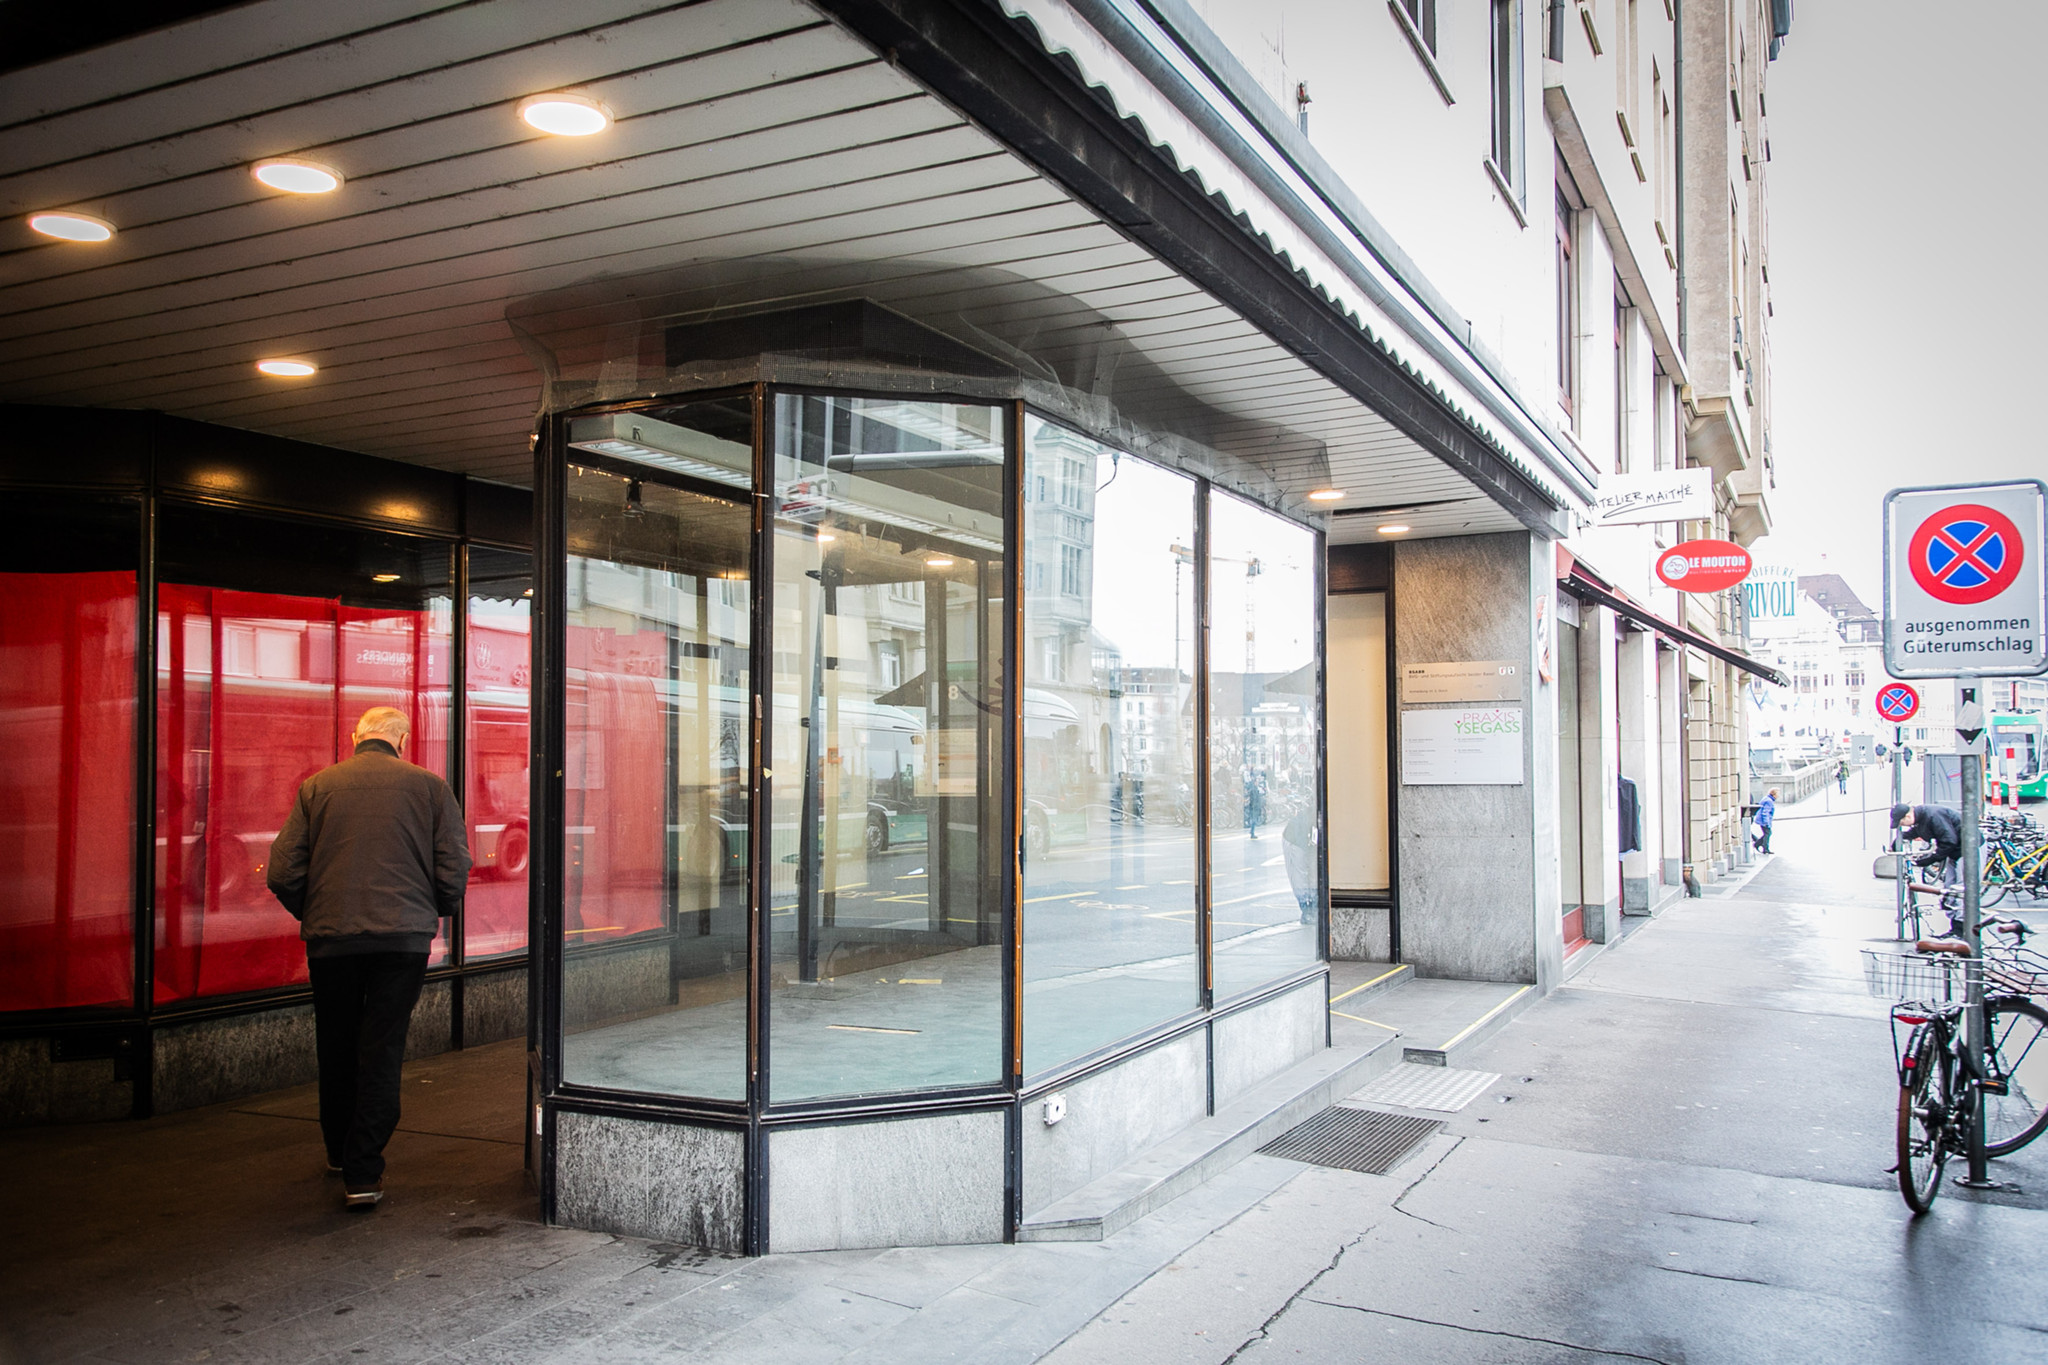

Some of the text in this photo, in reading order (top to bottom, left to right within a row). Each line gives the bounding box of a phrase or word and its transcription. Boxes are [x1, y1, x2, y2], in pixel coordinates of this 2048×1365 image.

[1590, 491, 1643, 511] ATELIER
[1688, 556, 1746, 568] LE MOUTON
[1905, 618, 2030, 636] ausgenommen
[1903, 636, 2033, 654] Güterumschlag
[1463, 710, 1515, 723] PRAXIS
[1454, 721, 1521, 734] YSEGASS
